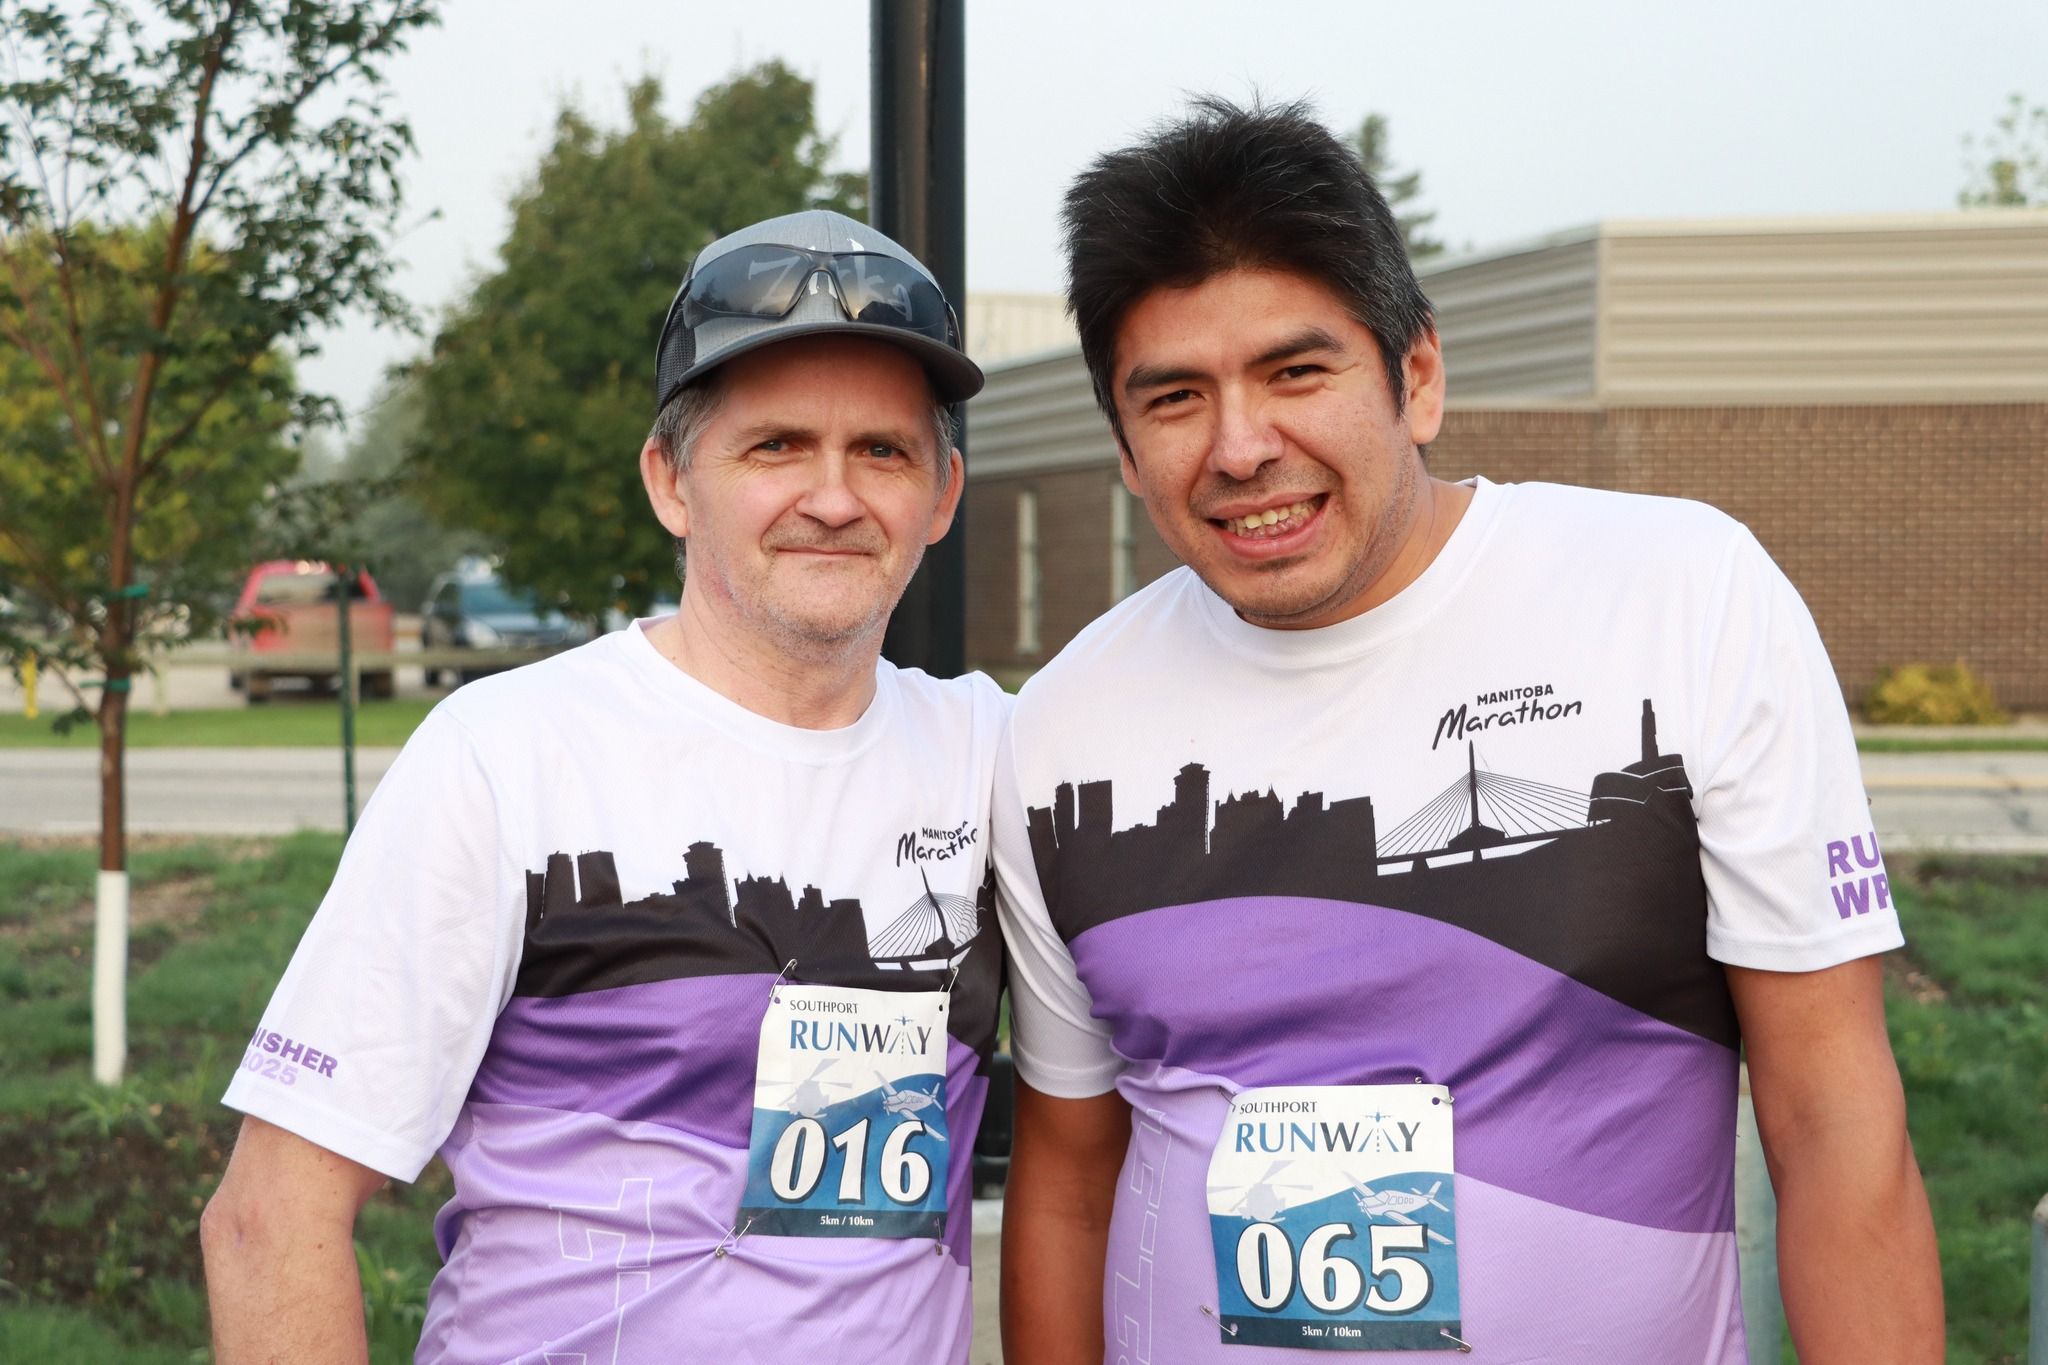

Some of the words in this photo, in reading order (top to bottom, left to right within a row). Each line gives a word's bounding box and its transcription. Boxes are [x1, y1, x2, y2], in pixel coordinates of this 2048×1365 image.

[1476, 683, 1554, 706] MANITOBA
[1432, 698, 1582, 750] Marathon
[789, 999, 859, 1015] SOUTHPORT
[789, 1018, 932, 1056] RUNWAY
[1239, 1101, 1318, 1114] SOUTHPORT
[1235, 1121, 1421, 1153] RUNWAY
[769, 1116, 932, 1206] 016
[820, 1215, 840, 1226] 5km
[841, 1216, 847, 1226] /
[849, 1215, 874, 1227] 10km
[1235, 1221, 1434, 1316] 065
[1301, 1326, 1322, 1337] 5km
[1325, 1326, 1330, 1337] /
[1333, 1326, 1361, 1338] 10km
